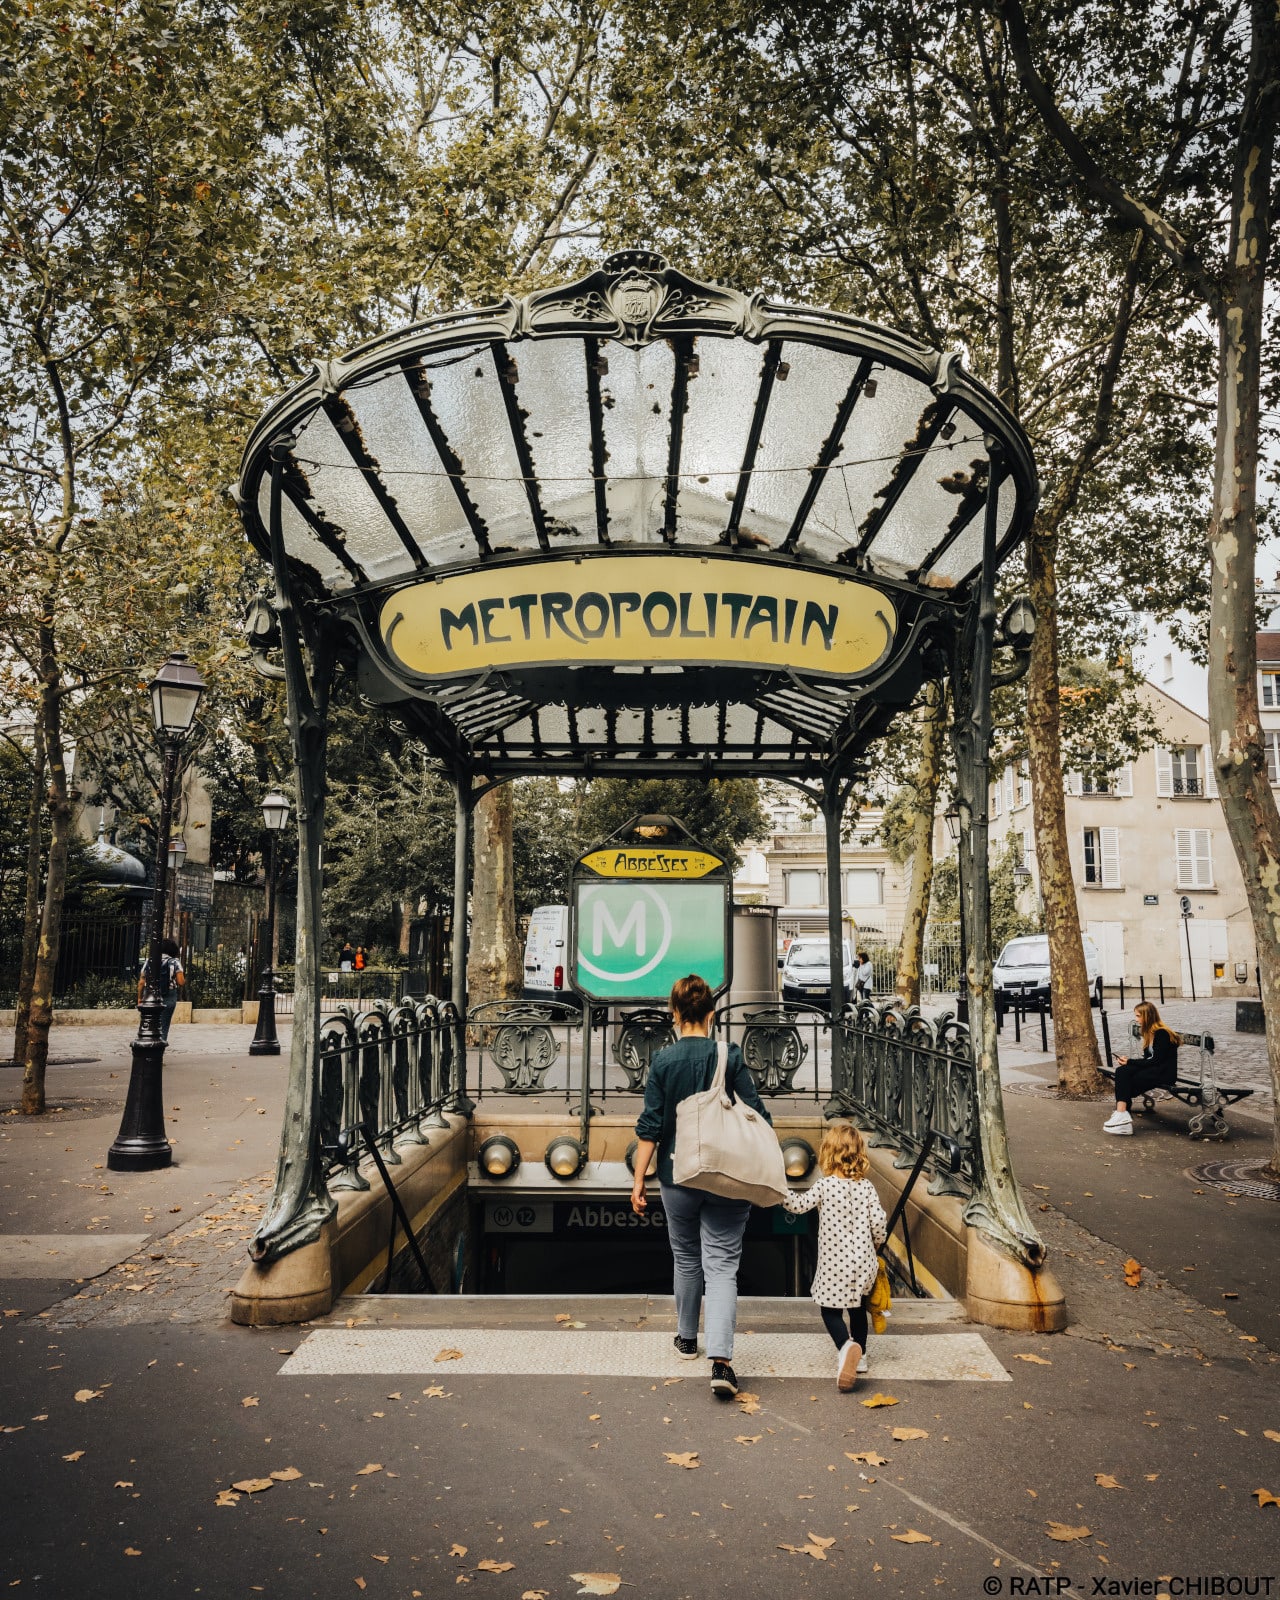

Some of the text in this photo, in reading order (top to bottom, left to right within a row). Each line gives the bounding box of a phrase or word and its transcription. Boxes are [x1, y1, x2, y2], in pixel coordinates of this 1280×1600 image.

[440, 591, 839, 650] METROPOLITAIN
[614, 853, 688, 872] ABBESSES
[593, 900, 646, 956] M
[567, 1206, 668, 1227] Abbesse
